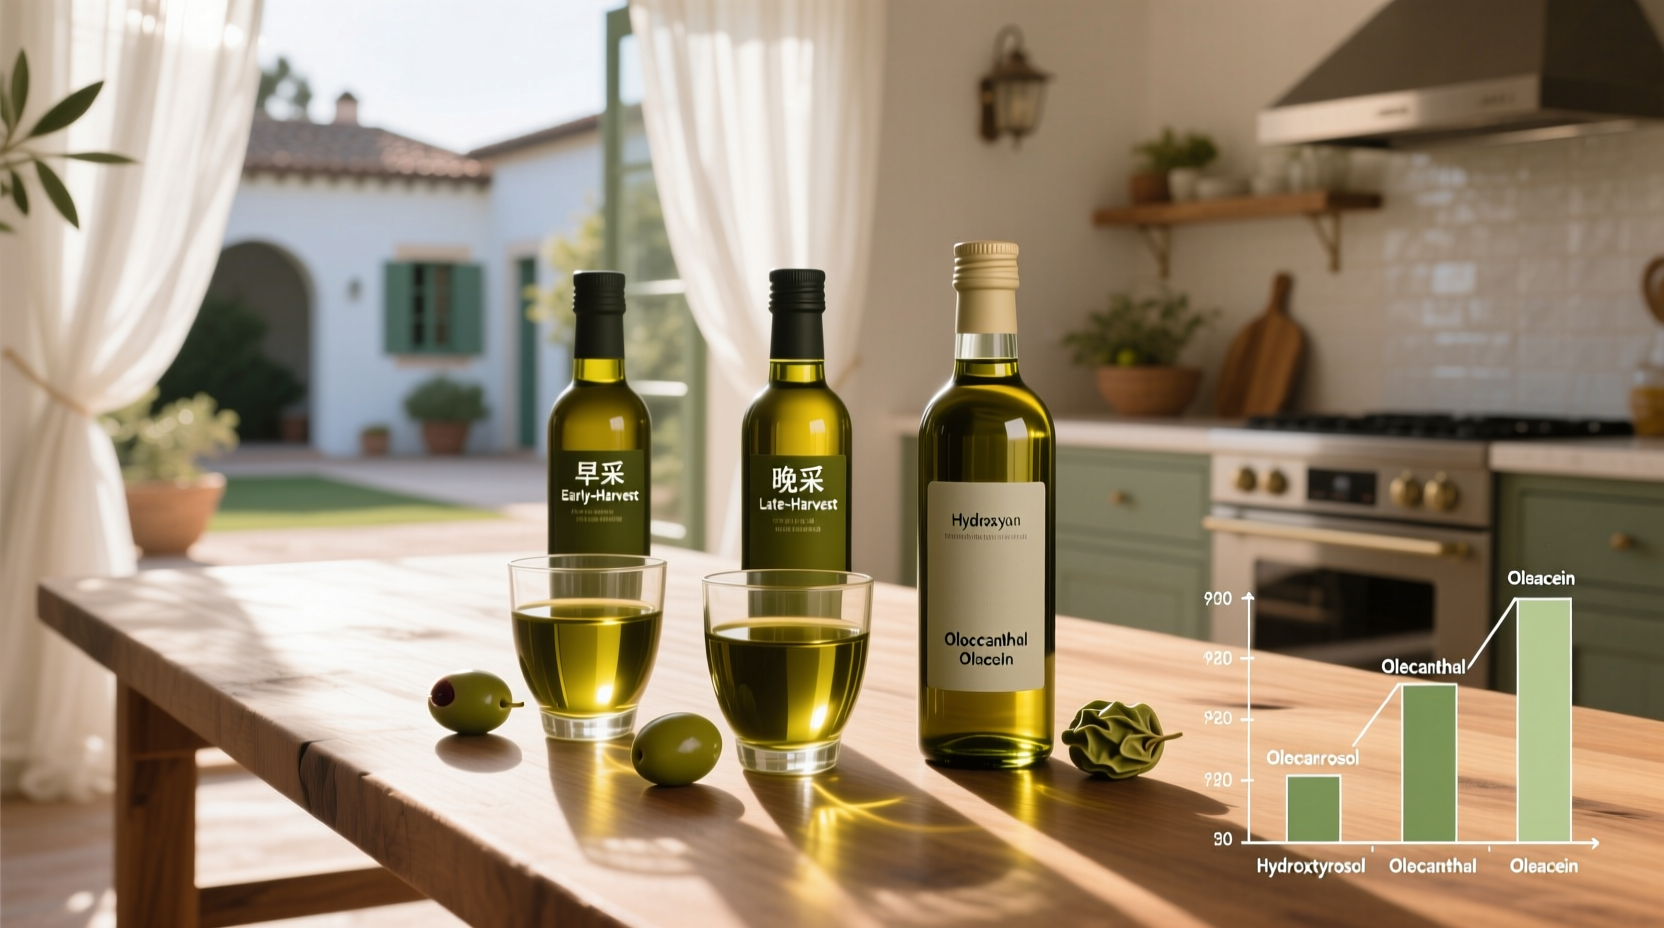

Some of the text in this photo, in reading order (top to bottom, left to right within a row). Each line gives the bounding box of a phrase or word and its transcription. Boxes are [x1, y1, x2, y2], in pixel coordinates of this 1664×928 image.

[575, 460, 624, 486] 早采
[772, 465, 824, 493] 晚采
[561, 489, 639, 505] Early-Harvest
[759, 497, 838, 511] Late-Harvest
